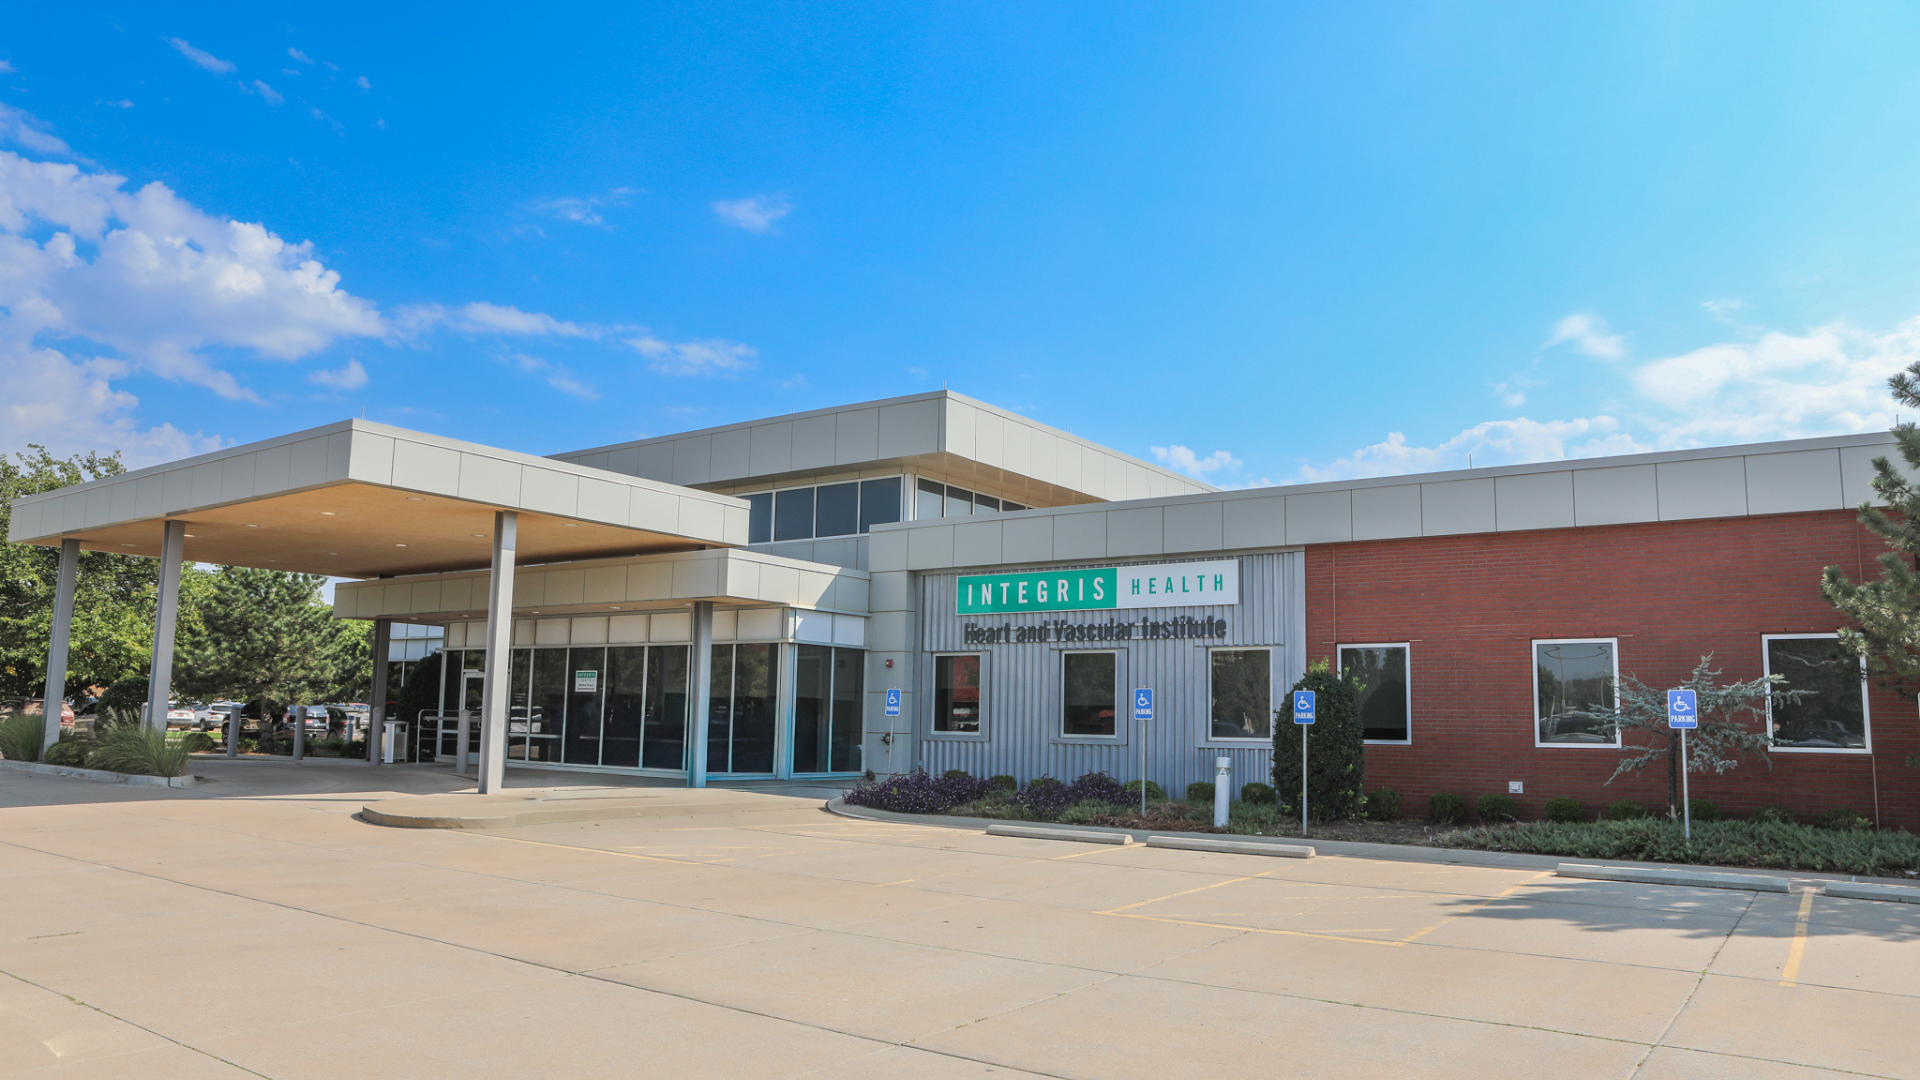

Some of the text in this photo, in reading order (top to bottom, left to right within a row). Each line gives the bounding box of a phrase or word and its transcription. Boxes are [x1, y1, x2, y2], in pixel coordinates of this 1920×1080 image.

[968, 574, 1223, 606] INTEGRIS HEALTH
[964, 615, 1227, 644] Heart and Vascular Institute
[1670, 715, 1695, 723] PARKING
